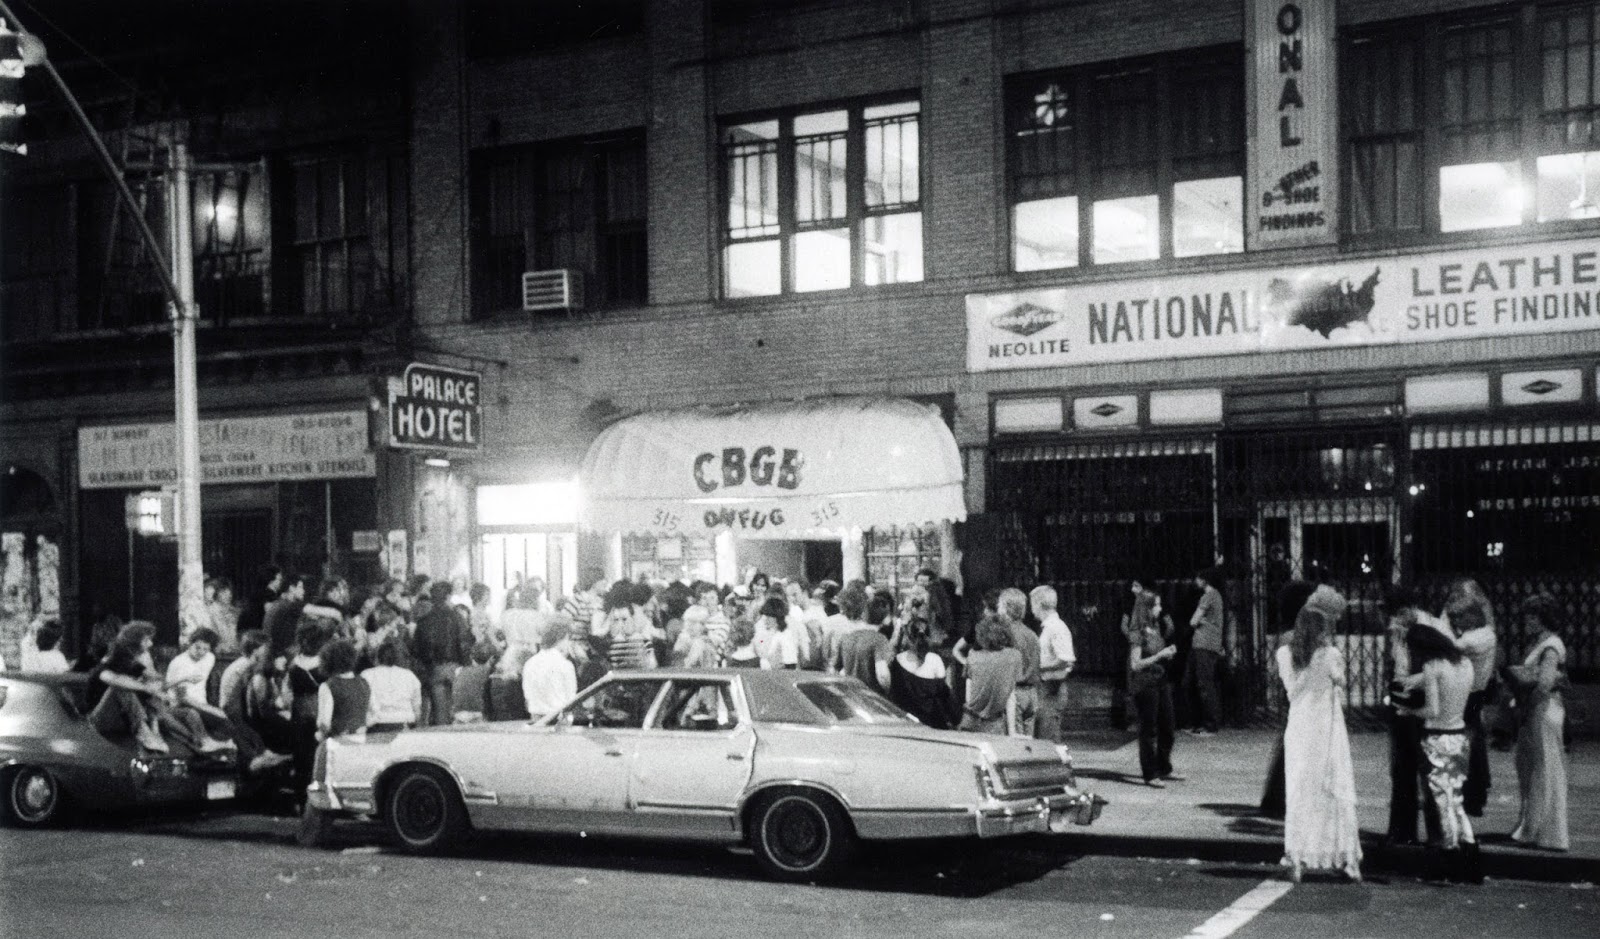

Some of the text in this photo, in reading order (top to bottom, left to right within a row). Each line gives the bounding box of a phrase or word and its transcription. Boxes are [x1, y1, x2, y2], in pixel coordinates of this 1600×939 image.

[1411, 251, 1598, 297] LEATHE
[1088, 290, 1260, 345] NATIONAL
[1407, 300, 1477, 331] SHOE
[988, 339, 1070, 358] NEOLITE
[411, 373, 475, 405] PALACE
[398, 403, 476, 443] HOTEL
[693, 446, 804, 493] CBGB
